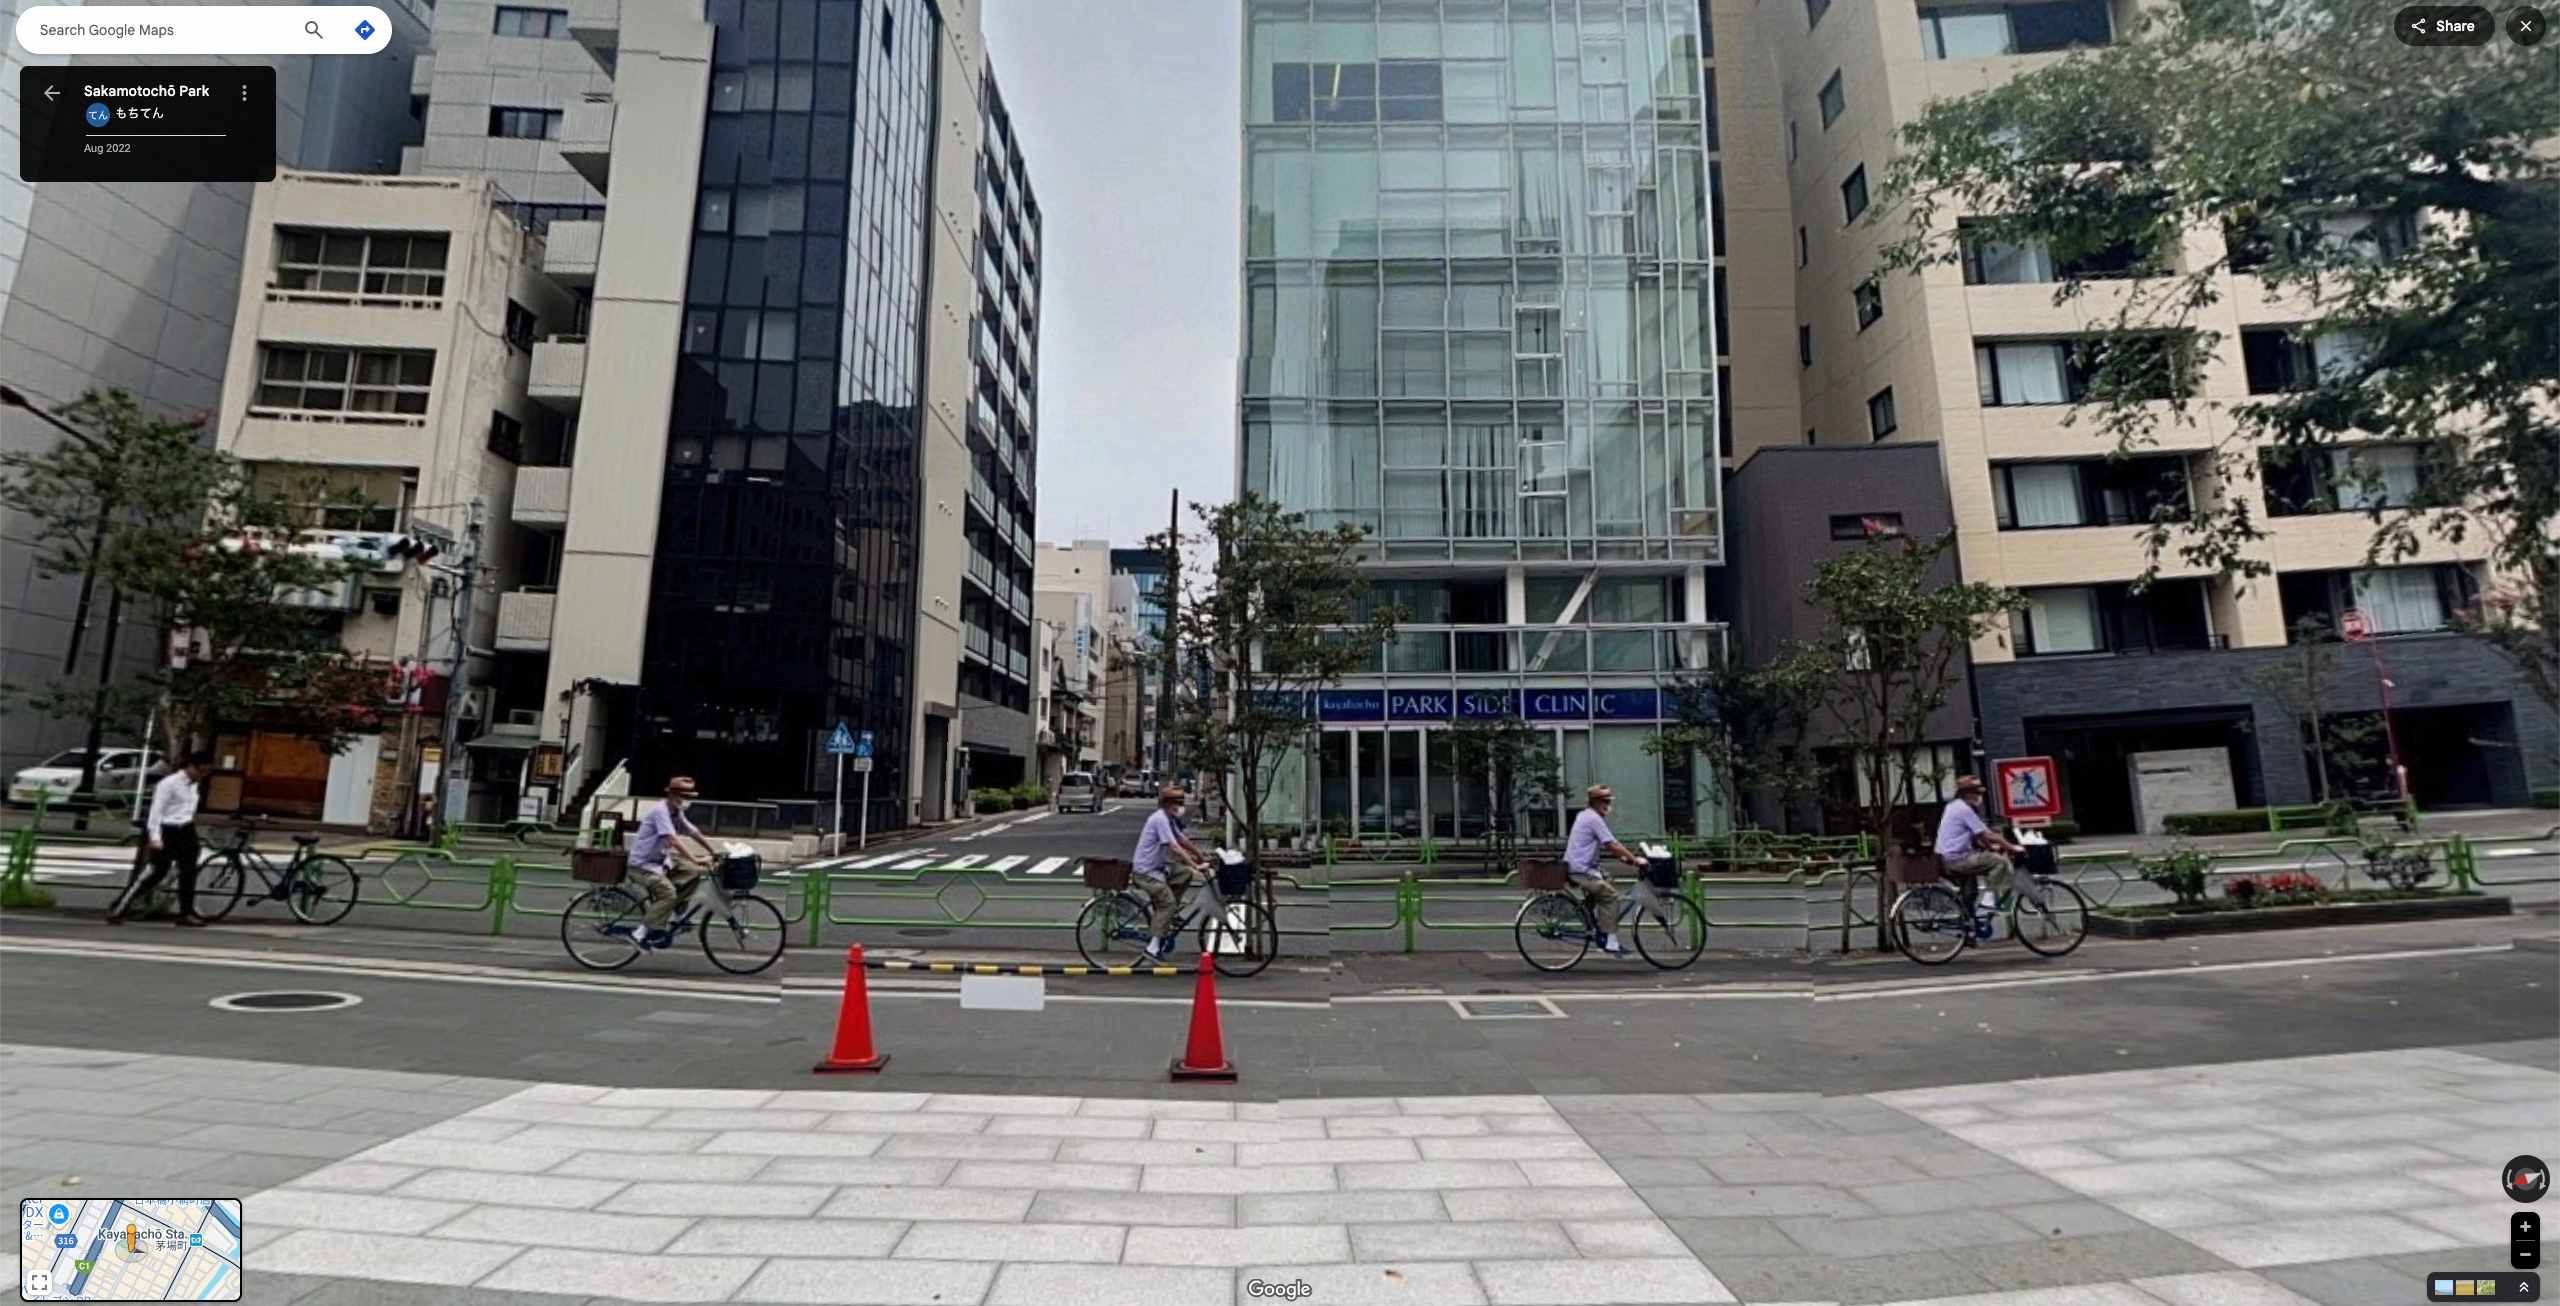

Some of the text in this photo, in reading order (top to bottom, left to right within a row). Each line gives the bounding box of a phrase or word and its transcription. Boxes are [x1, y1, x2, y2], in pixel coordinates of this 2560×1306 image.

[1391, 695, 1448, 714] PARK
[1463, 694, 1513, 715] SIDE
[1534, 694, 1617, 714] CLINIC
